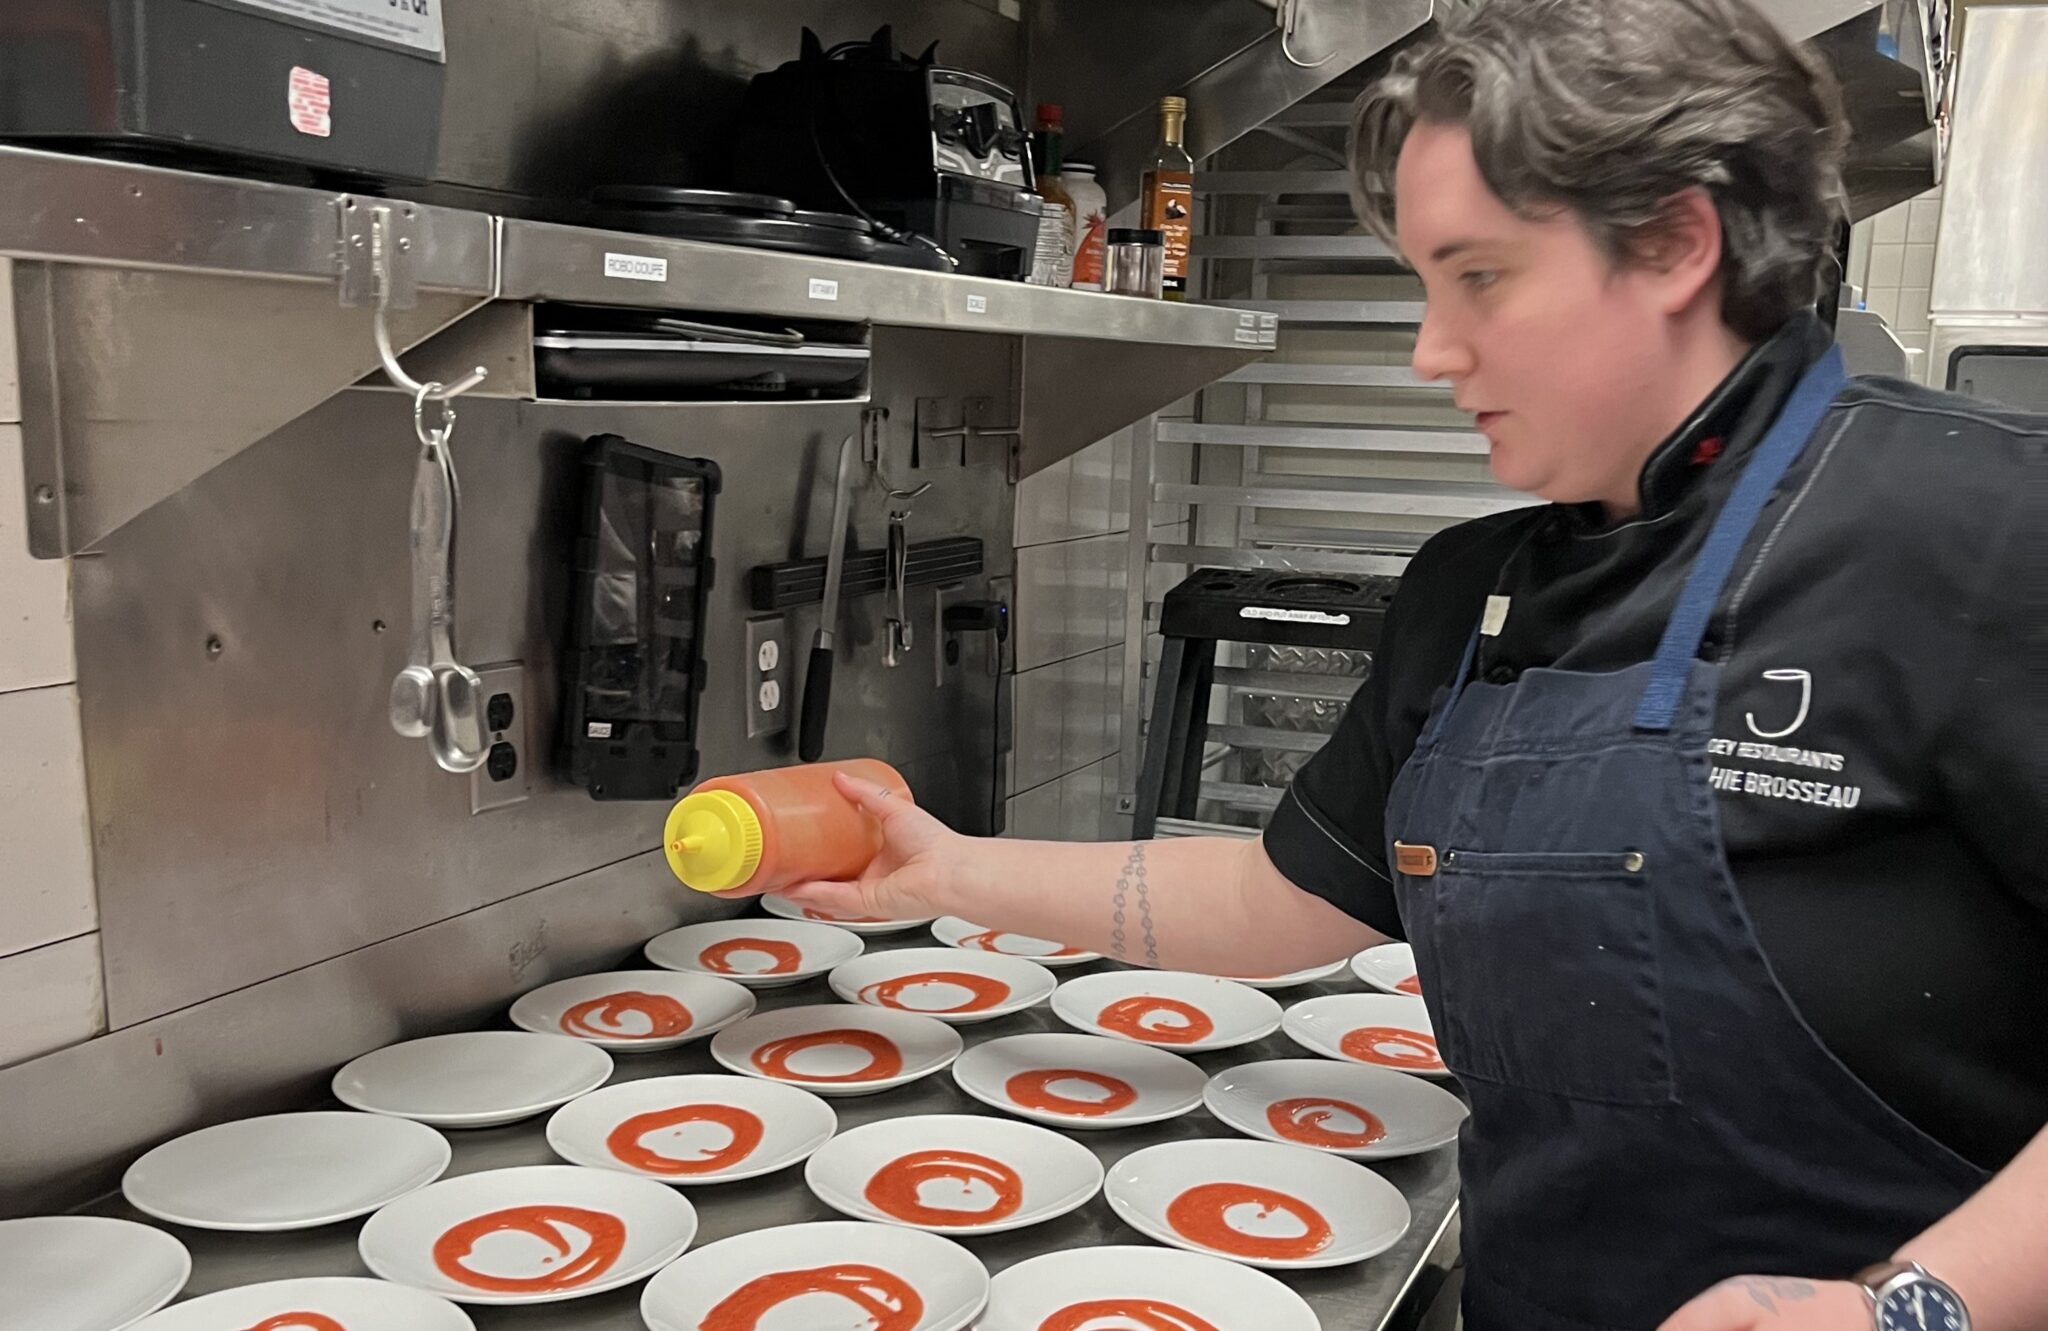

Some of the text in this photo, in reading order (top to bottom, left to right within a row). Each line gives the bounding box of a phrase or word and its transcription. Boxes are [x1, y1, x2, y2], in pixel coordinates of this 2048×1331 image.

[608, 258, 633, 273] ROBO
[1736, 741, 1845, 772] RESTAURANTS
[1743, 771, 1862, 809] BROSSEAU
